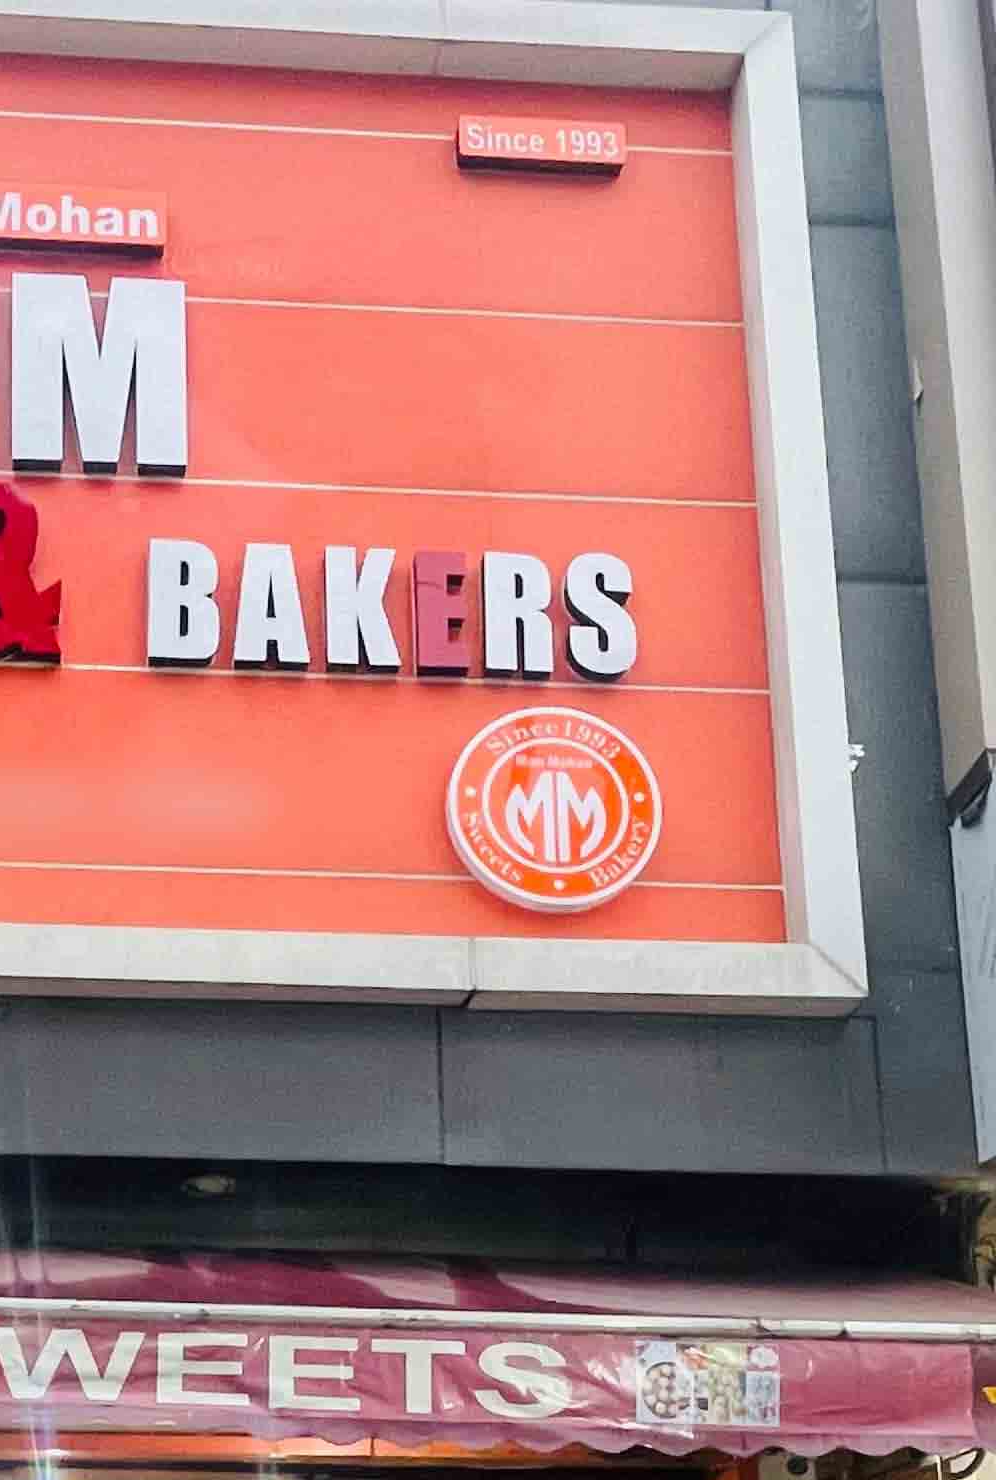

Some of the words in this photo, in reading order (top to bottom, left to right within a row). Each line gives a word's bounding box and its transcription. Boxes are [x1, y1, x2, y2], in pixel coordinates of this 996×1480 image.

[467, 123, 544, 154] Since
[556, 129, 619, 158] 1993
[146, 538, 637, 681] BAKERS
[485, 720, 558, 756] Since
[505, 770, 607, 863] MM
